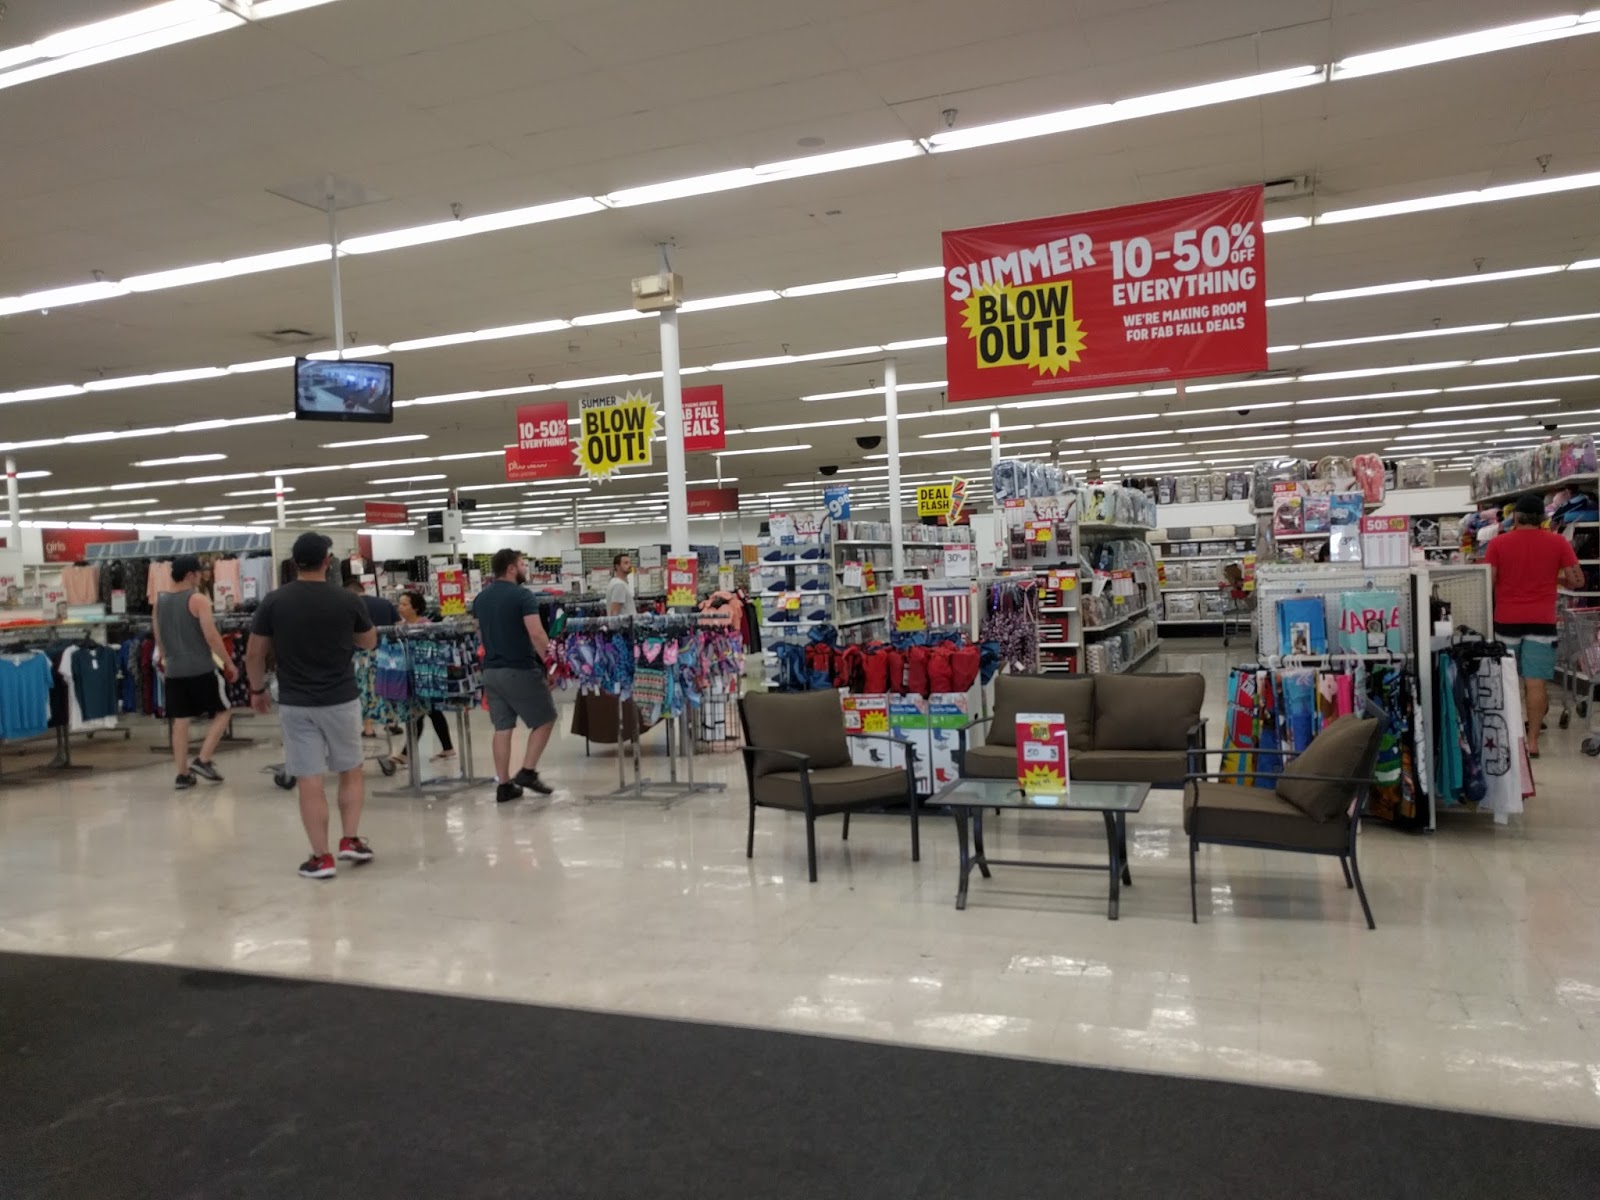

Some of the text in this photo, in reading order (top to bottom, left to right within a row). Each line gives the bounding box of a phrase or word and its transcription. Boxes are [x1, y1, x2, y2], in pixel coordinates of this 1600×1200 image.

[1109, 221, 1256, 280] 10-50% OFF
[947, 233, 1097, 301] SUMMER
[1112, 266, 1257, 306] EVERYTHING
[978, 285, 1069, 326] BLOW
[1123, 301, 1248, 327] WE'RE MAKING ROOM
[980, 318, 1067, 364] OUT!
[1126, 317, 1246, 342] FOR FAB FALL DEALS
[581, 396, 617, 409] SUMMER
[695, 406, 719, 419] FALL
[586, 406, 646, 435] BLOW
[683, 419, 720, 437] EALS
[520, 436, 568, 449] EVERYTHING!
[588, 431, 646, 465] OUT!
[920, 488, 949, 500] DEAL
[921, 500, 949, 510] FLASH
[1038, 507, 1066, 519] SALE
[45, 541, 66, 553] girls
